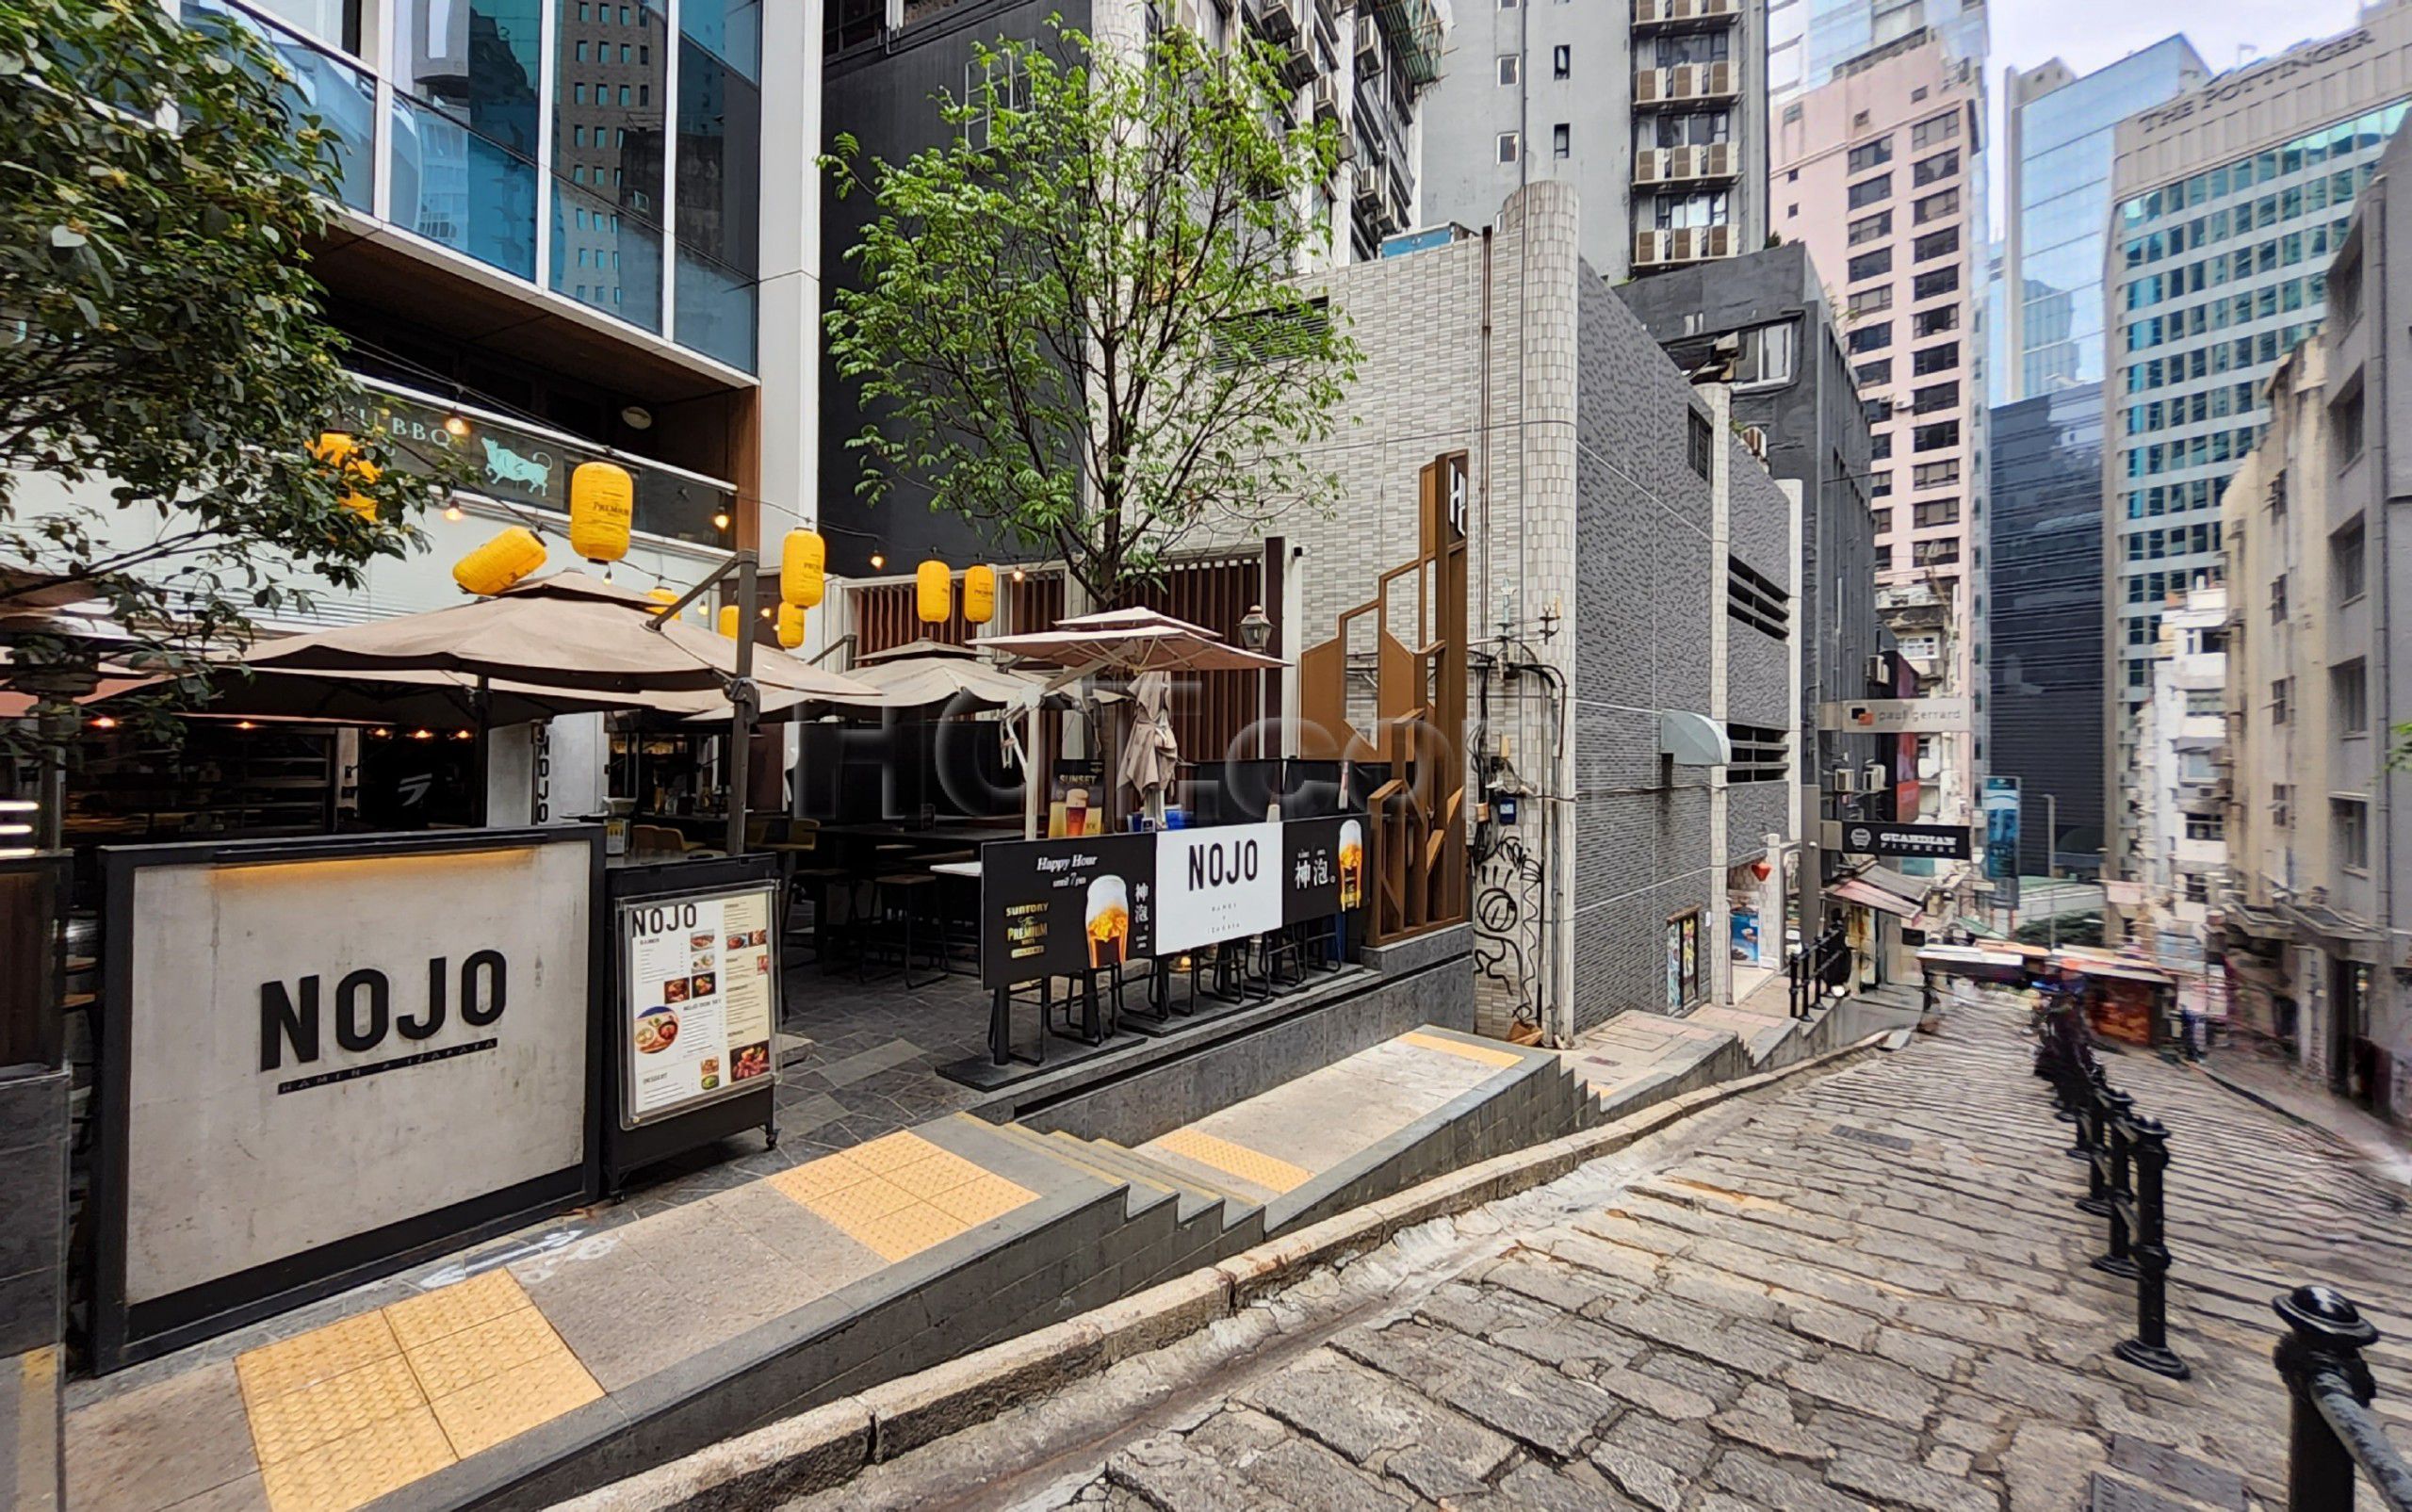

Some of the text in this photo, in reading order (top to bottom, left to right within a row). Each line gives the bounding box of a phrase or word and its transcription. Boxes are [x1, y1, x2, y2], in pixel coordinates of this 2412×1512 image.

[2138, 29, 2375, 134] THE POTTINGER
[1059, 774, 1097, 785] SUNSET
[1036, 854, 1098, 872] Happy Hour
[1189, 838, 1258, 891] NOJO
[632, 903, 696, 937] NOJO
[1006, 902, 1049, 917] SUNTORY
[260, 950, 506, 1072] NOJO
